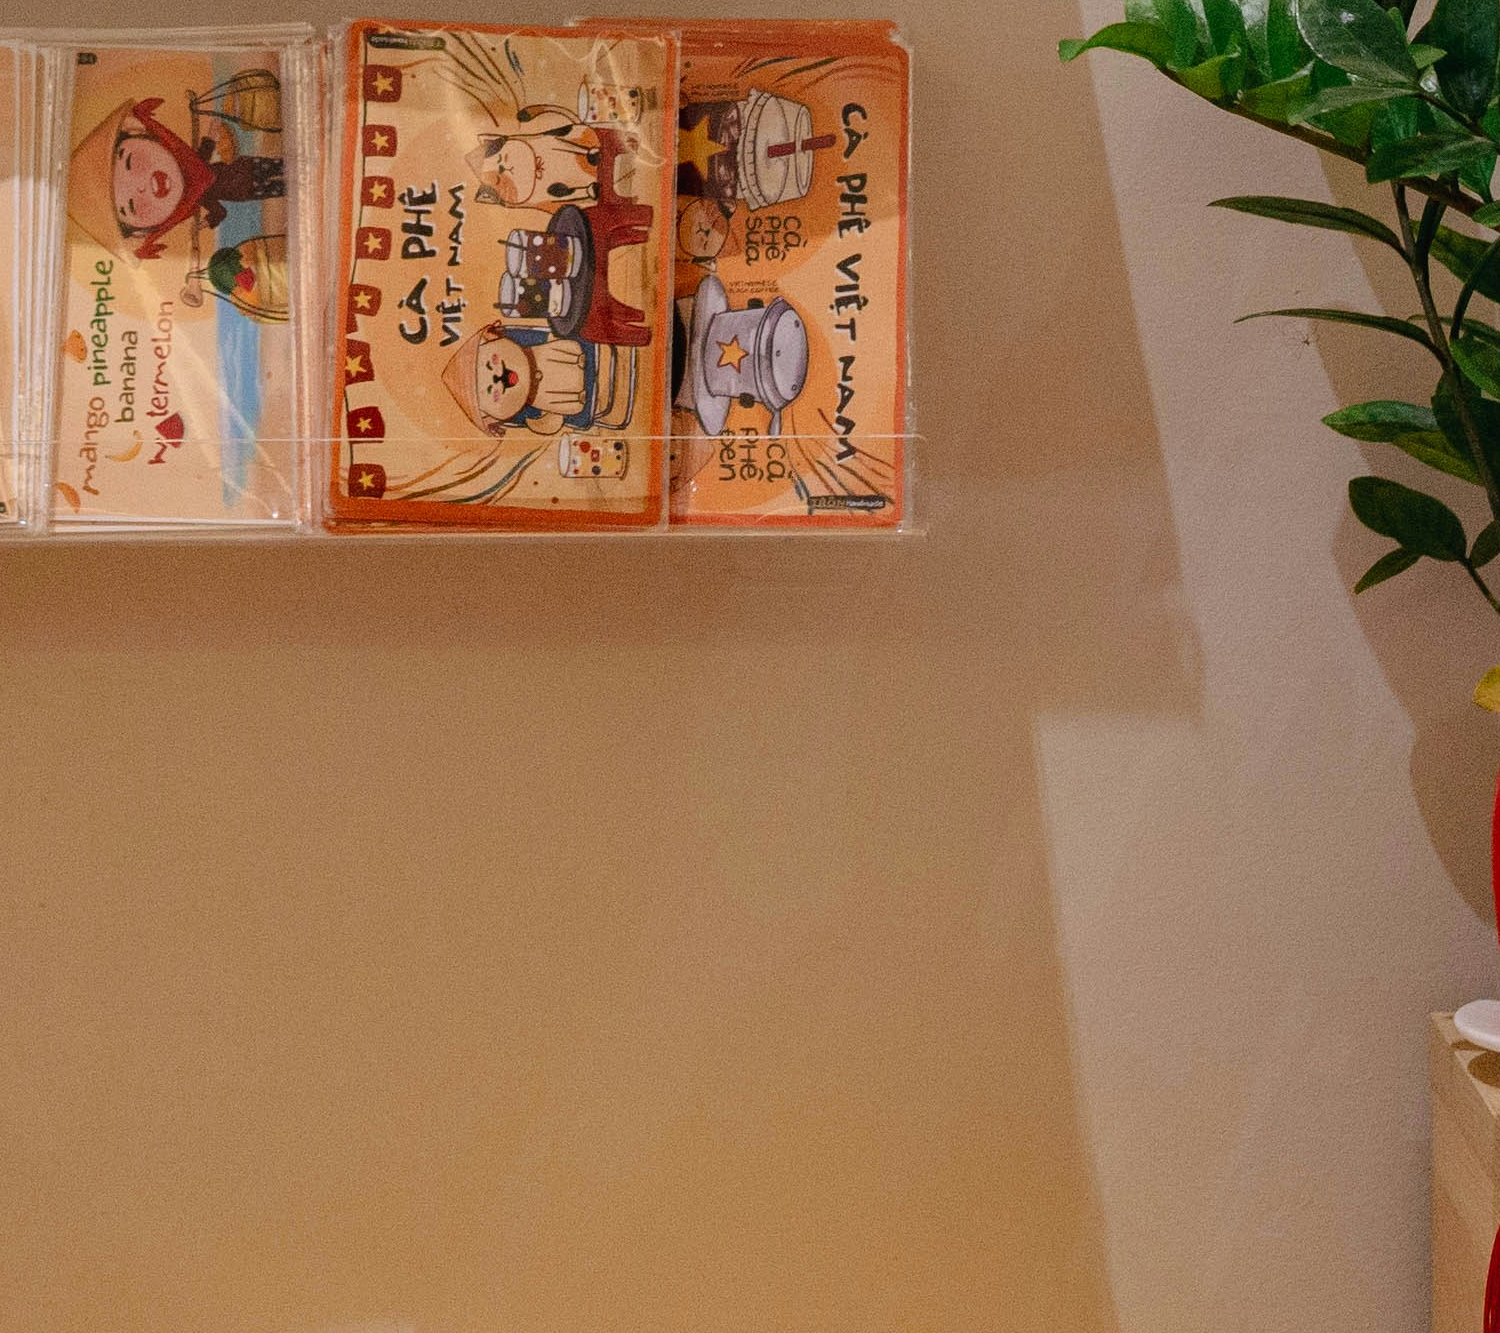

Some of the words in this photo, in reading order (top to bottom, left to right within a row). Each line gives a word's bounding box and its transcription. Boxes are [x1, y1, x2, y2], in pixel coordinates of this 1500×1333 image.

[838, 101, 869, 161] CÀ
[397, 182, 438, 260] PHÊ
[447, 183, 466, 267] NAM
[835, 171, 872, 240] PHÊ
[86, 258, 116, 387] pineapple
[397, 276, 429, 346] CÀ
[435, 276, 467, 347] VIỆT
[828, 252, 864, 343] VIỆT
[113, 329, 140, 424] banana
[834, 354, 858, 465] NAM
[79, 395, 110, 496] mango
